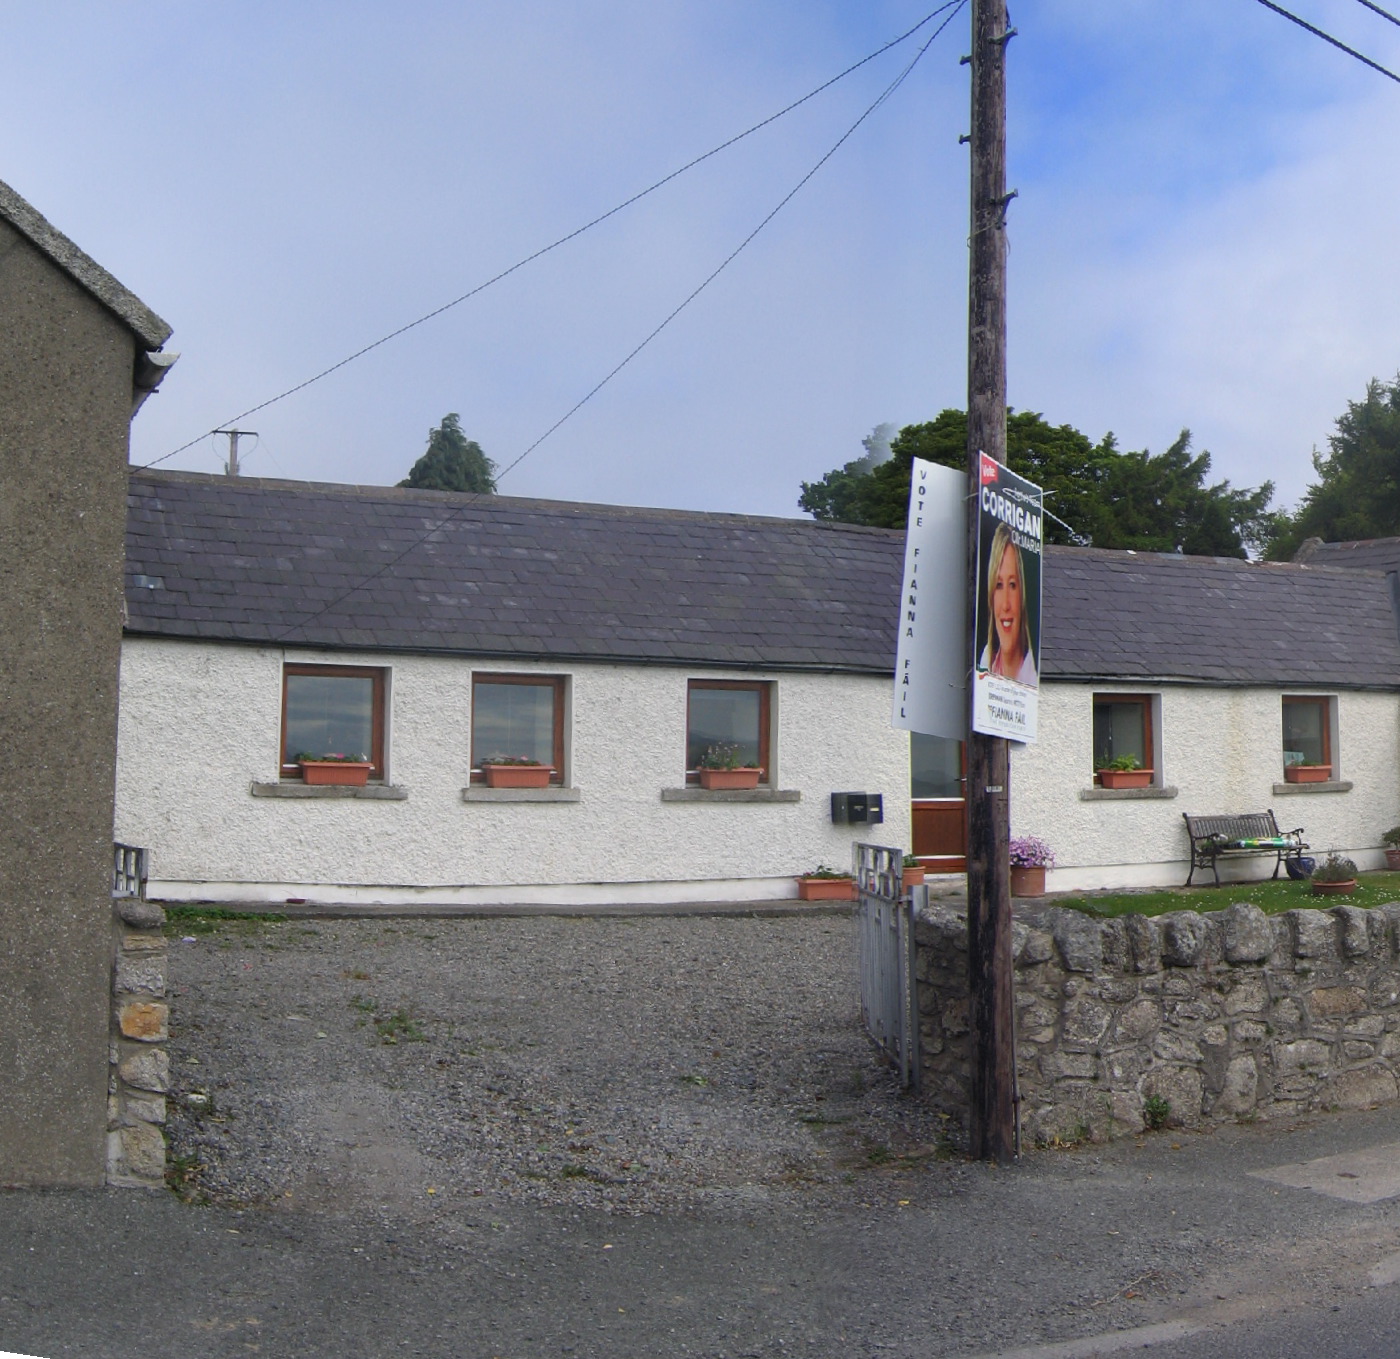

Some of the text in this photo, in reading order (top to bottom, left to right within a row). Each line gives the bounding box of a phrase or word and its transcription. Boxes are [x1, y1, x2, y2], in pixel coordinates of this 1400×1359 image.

[982, 486, 1041, 540] CORRIGAN
[900, 470, 927, 718] VOTE FIANNA FÁIL
[991, 705, 1014, 722] FIANNA
